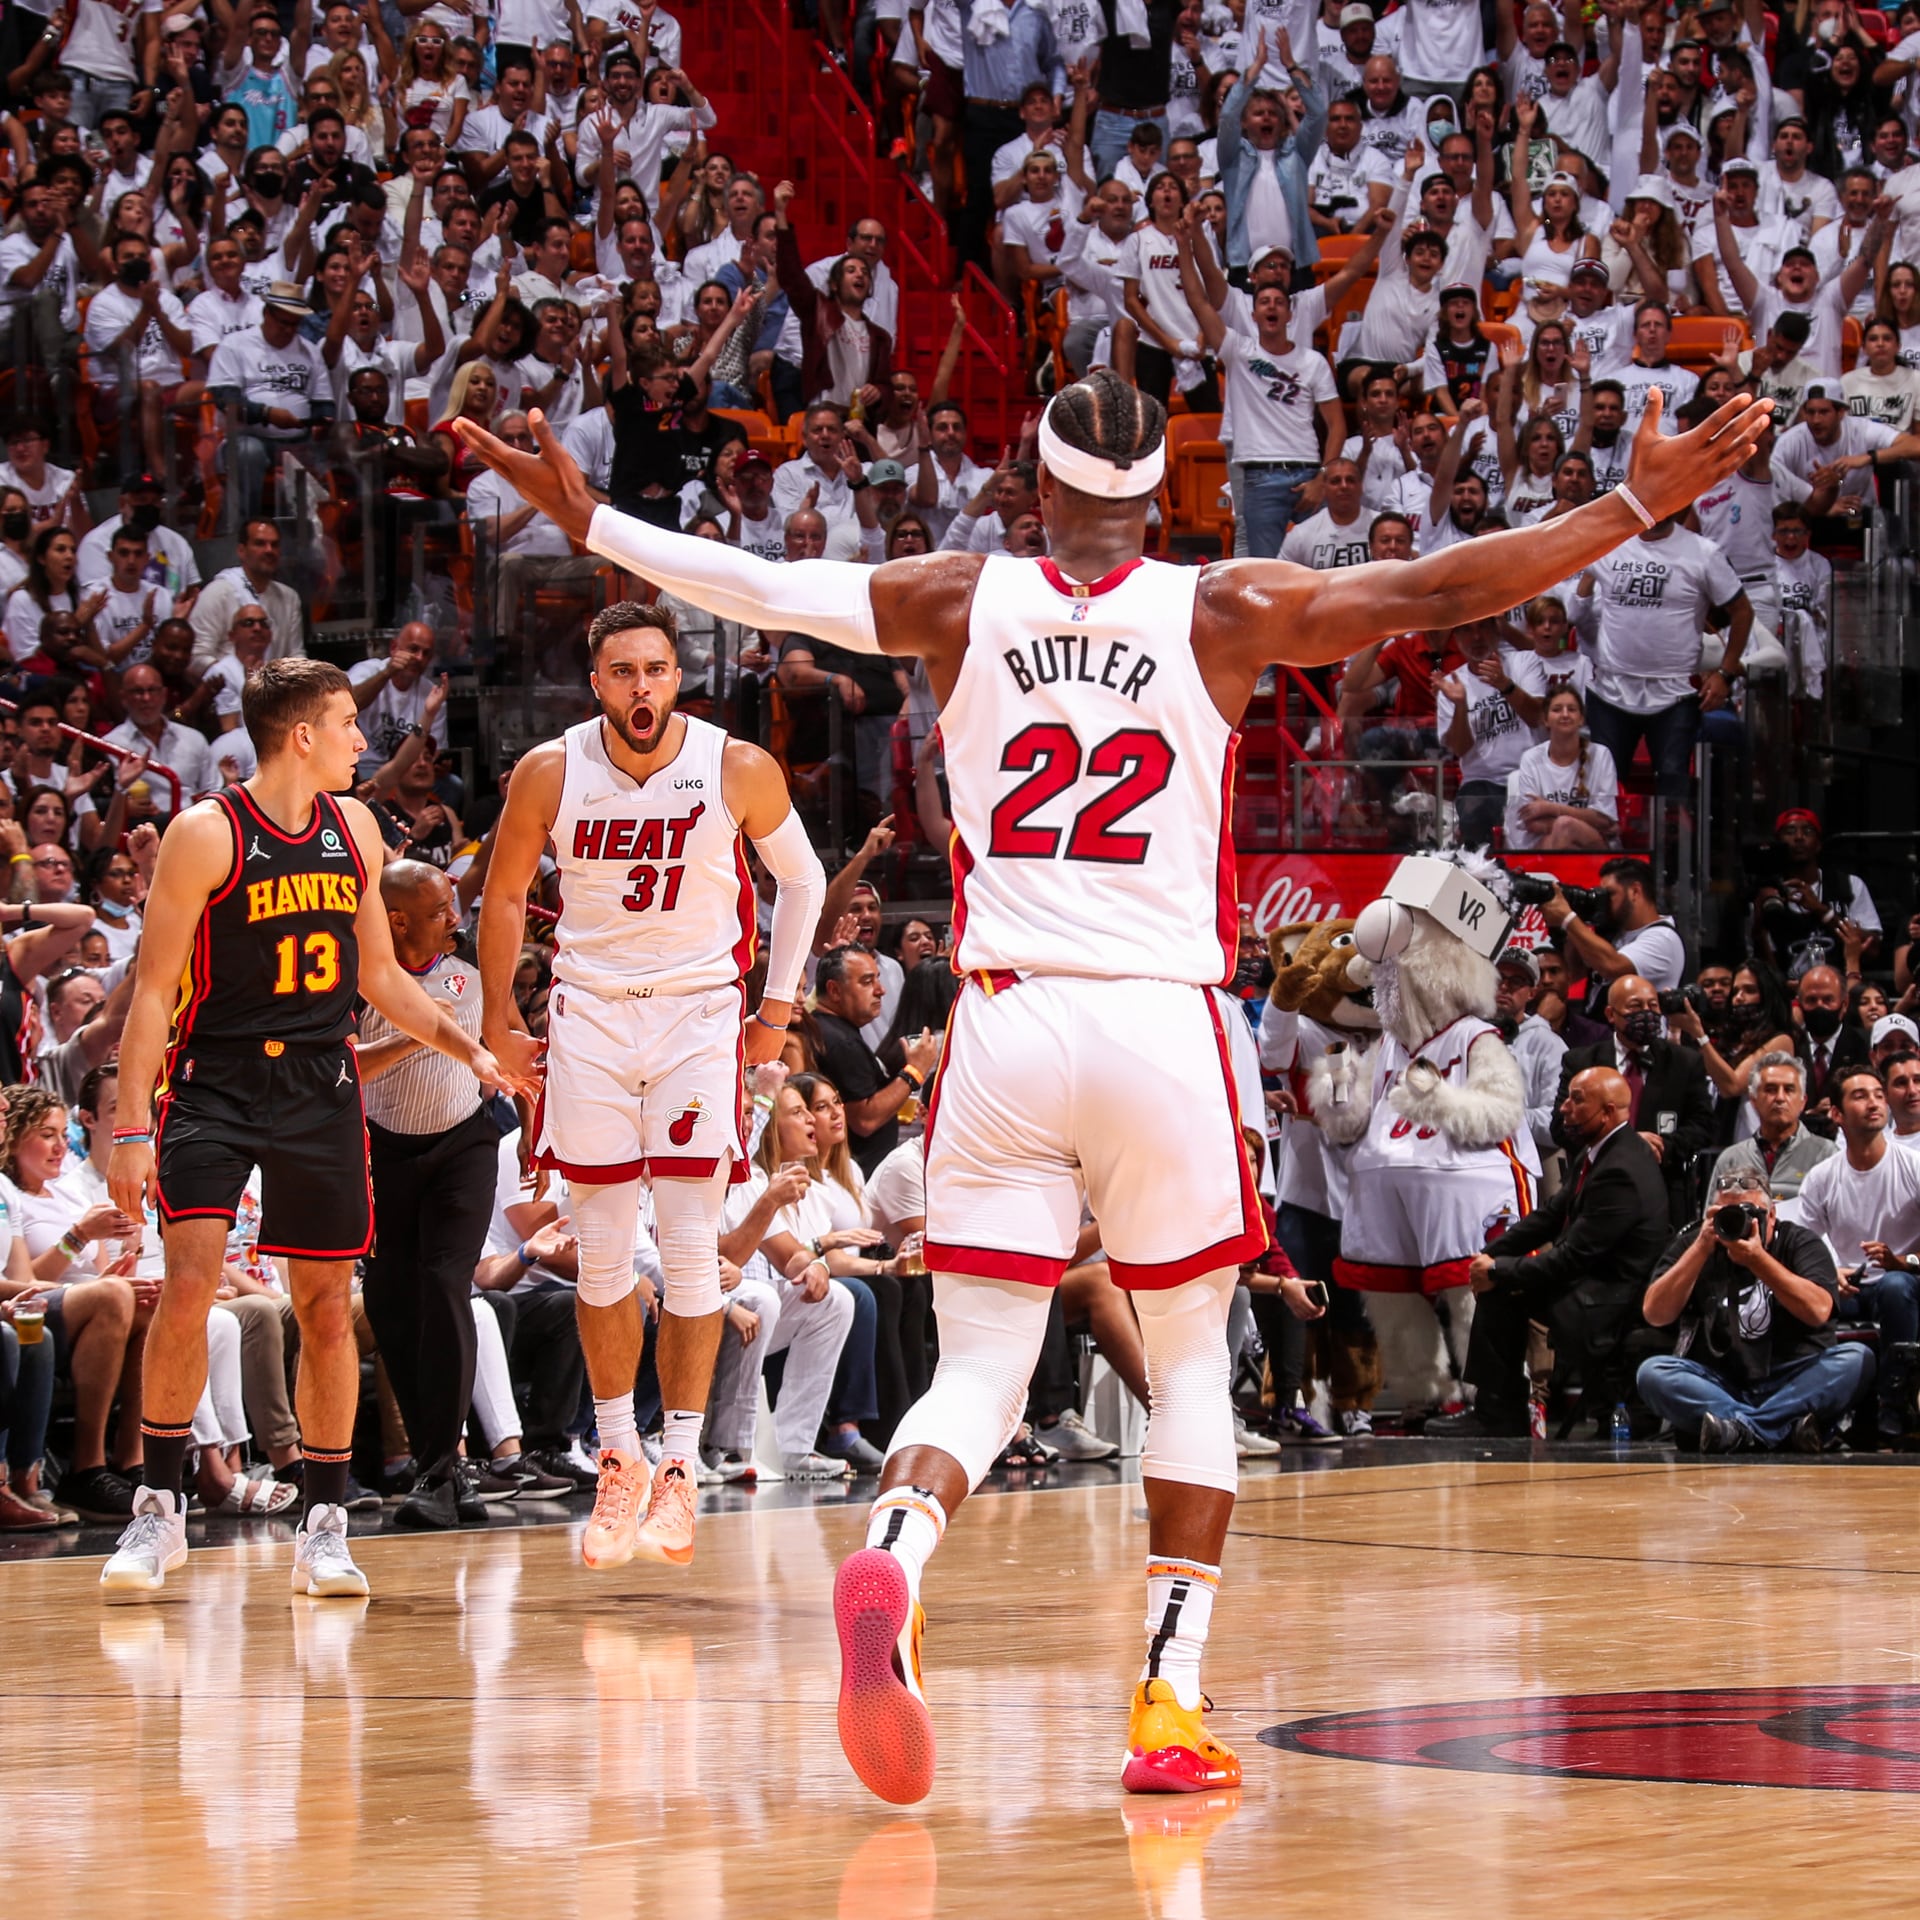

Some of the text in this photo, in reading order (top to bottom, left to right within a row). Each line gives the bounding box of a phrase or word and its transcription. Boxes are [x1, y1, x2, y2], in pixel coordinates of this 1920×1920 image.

[616, 10, 664, 38] HET
[1149, 254, 1181, 270] HEA
[287, 362, 307, 372] Go
[1267, 381, 1301, 406] 22
[1479, 454, 1498, 465] et's
[1730, 505, 1742, 525] 3
[743, 544, 765, 555] et's
[1612, 560, 1667, 575] Let's Go
[1793, 581, 1811, 594] Go
[1003, 635, 1158, 703] BUTLER
[674, 779, 704, 790] UKG
[987, 722, 1176, 865] 22
[1547, 790, 1568, 803] et's
[573, 801, 706, 861] HEAT
[247, 872, 358, 924] HAWKS
[621, 864, 686, 913] 31
[1458, 890, 1487, 932] VR
[273, 930, 341, 994] 13
